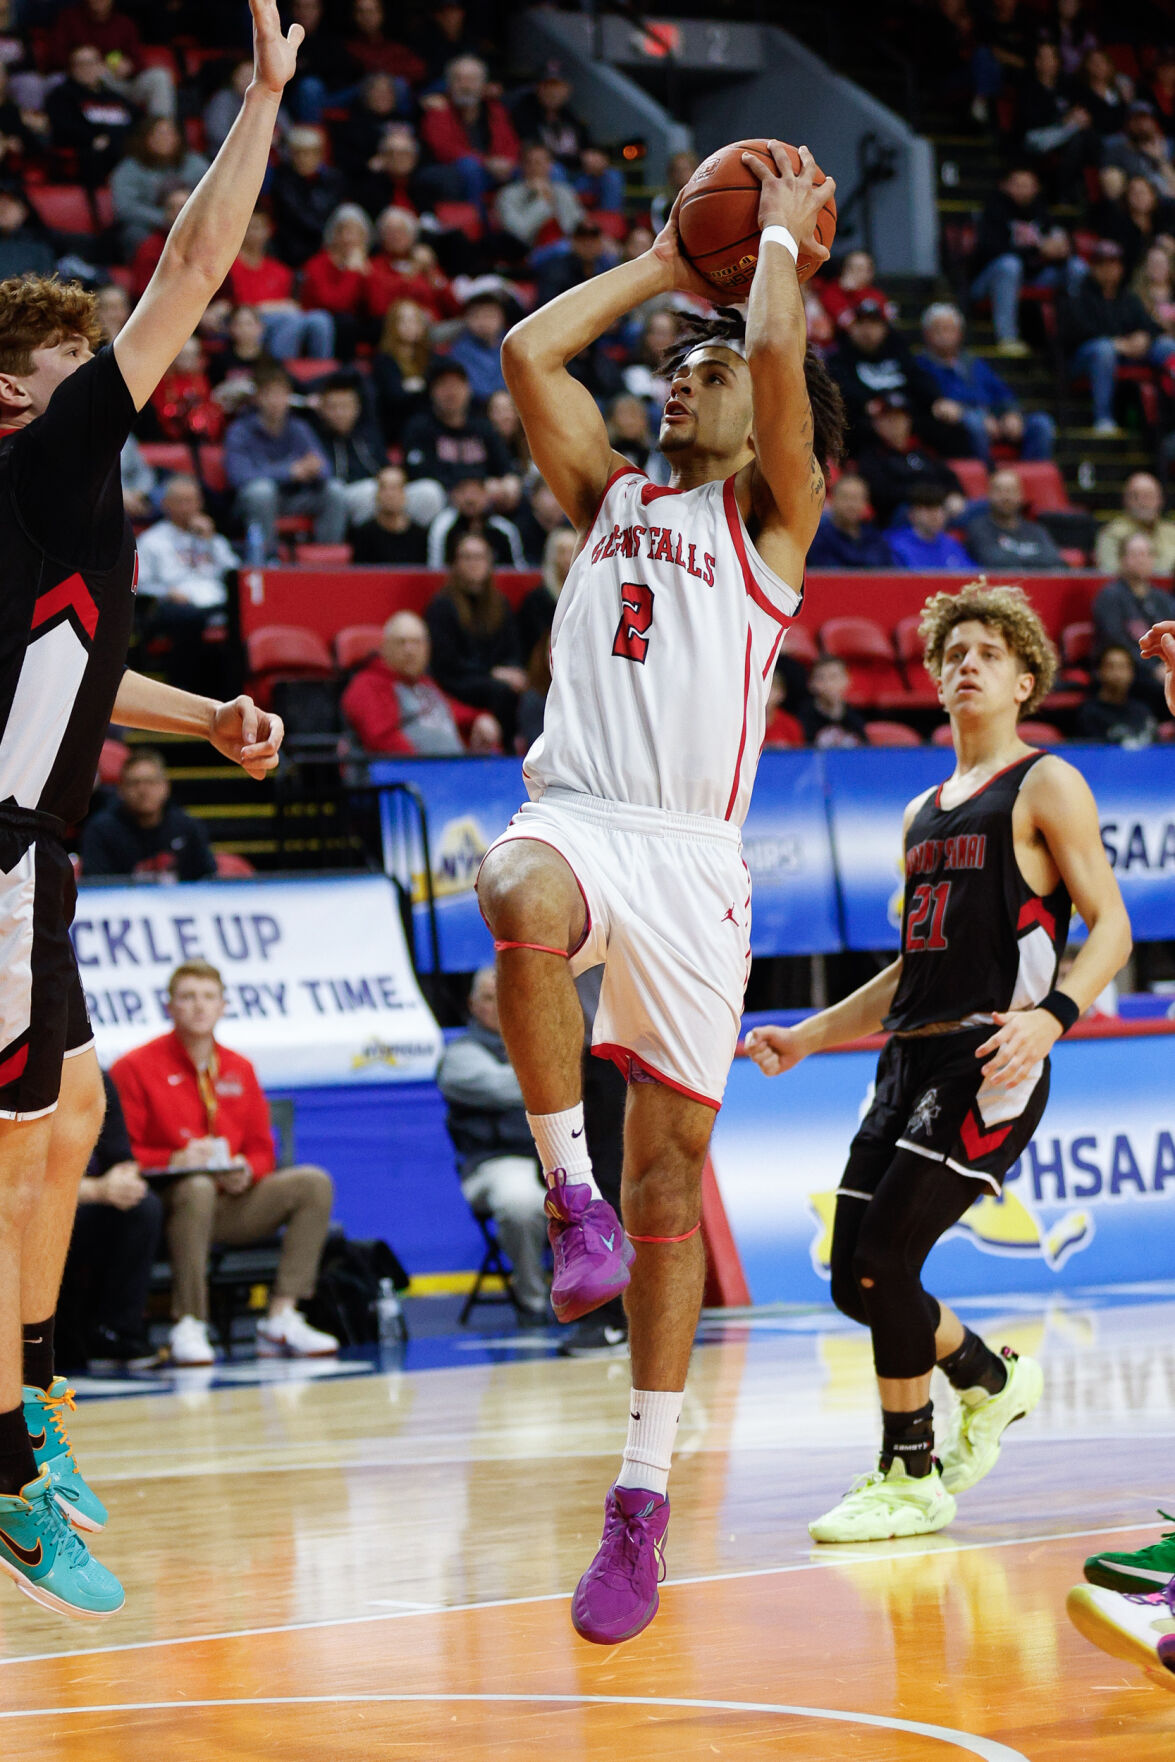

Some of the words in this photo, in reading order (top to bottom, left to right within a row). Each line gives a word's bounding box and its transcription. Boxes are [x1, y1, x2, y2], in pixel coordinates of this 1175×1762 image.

[647, 527, 716, 588] FALLS
[243, 573, 264, 605] 1
[611, 582, 655, 665] 2
[213, 911, 281, 960] UP
[906, 881, 951, 953] 21
[153, 981, 287, 1021] ERY
[302, 975, 416, 1015] TIME.
